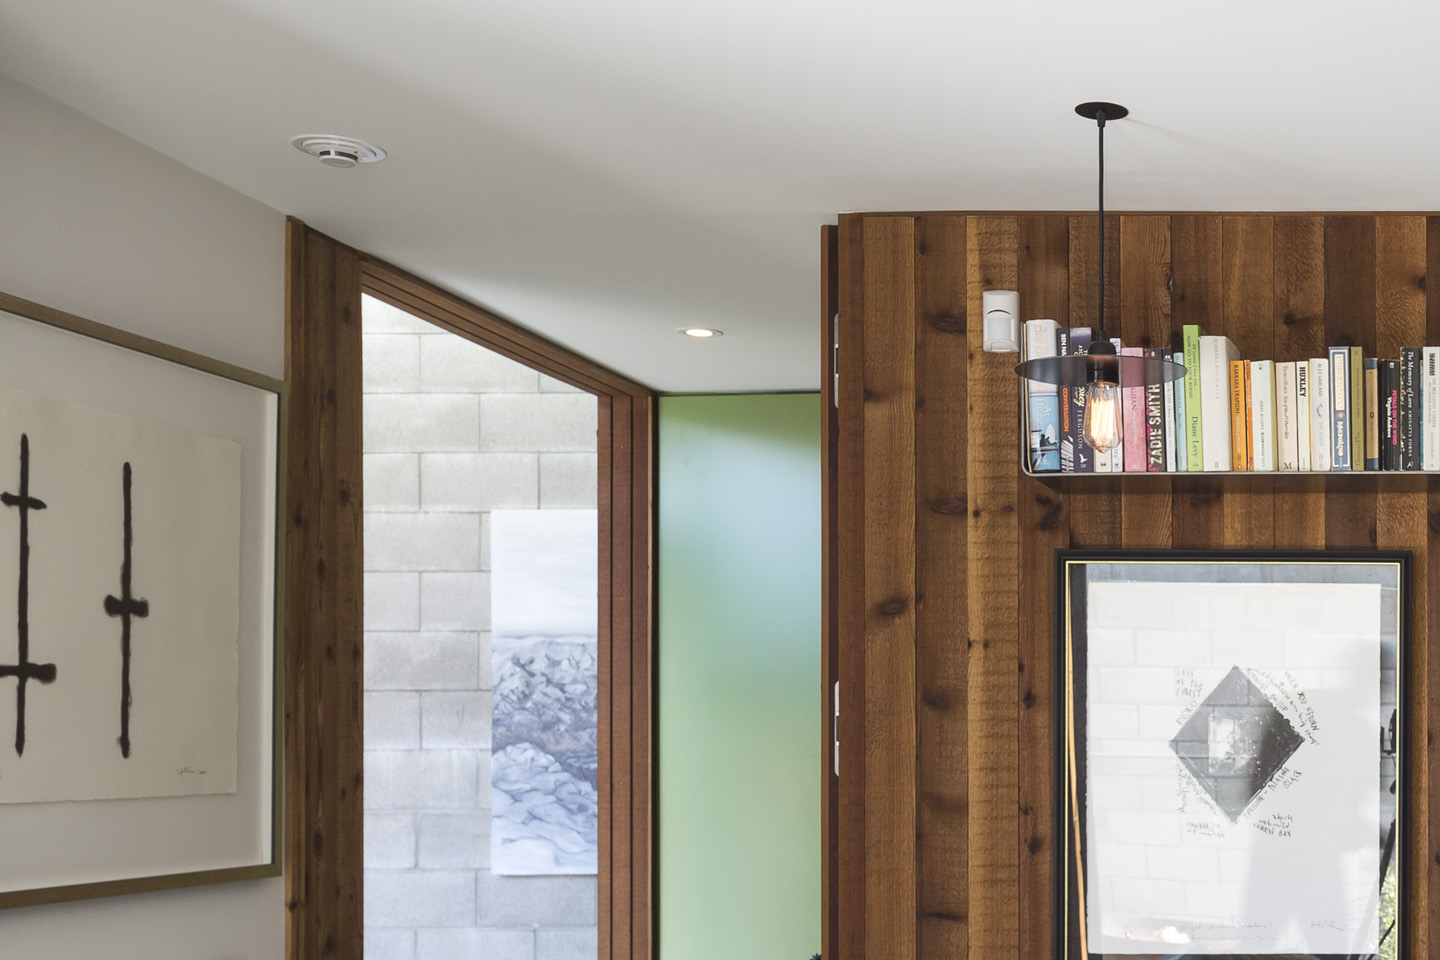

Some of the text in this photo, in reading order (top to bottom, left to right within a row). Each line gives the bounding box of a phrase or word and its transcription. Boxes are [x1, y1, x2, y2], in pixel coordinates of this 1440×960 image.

[1392, 409, 1397, 417] ON
[1149, 385, 1162, 464] ZADIE SMITH
[1191, 440, 1199, 457] Levy
